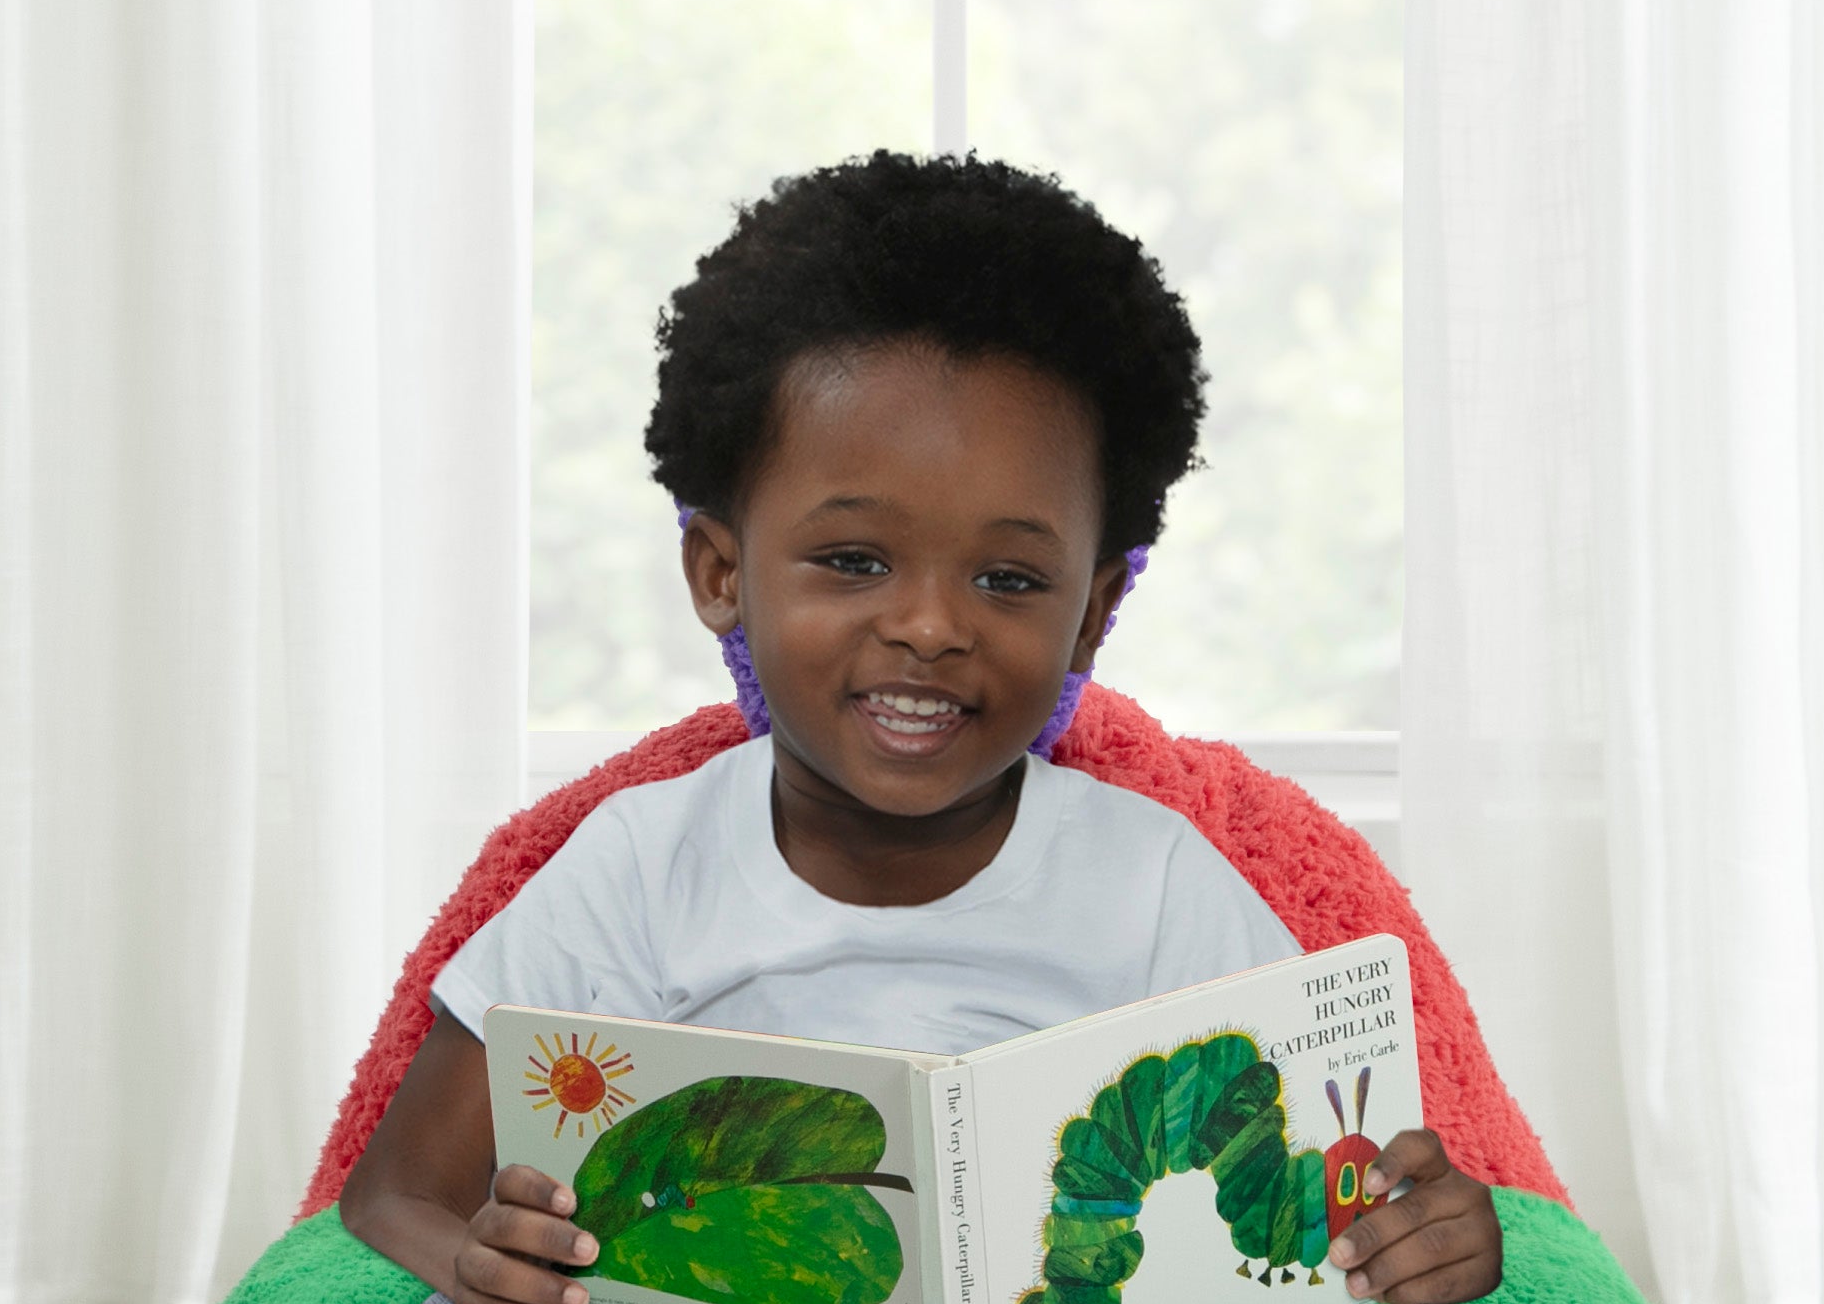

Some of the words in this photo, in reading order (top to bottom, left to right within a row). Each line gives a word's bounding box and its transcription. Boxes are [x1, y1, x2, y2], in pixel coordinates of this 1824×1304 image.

[1302, 972, 1342, 997] THE
[1345, 957, 1392, 984] VERY
[1315, 983, 1394, 1020] HUNGRY
[1269, 1009, 1396, 1060] CATERPILLAR
[1327, 1058, 1341, 1073] by
[1344, 1051, 1367, 1066] Eric
[1370, 1040, 1399, 1058] Carle
[947, 1083, 961, 1114] The
[947, 1118, 963, 1155] Very
[951, 1160, 966, 1218] Hungry
[955, 1223, 974, 1304] Caterpillar
